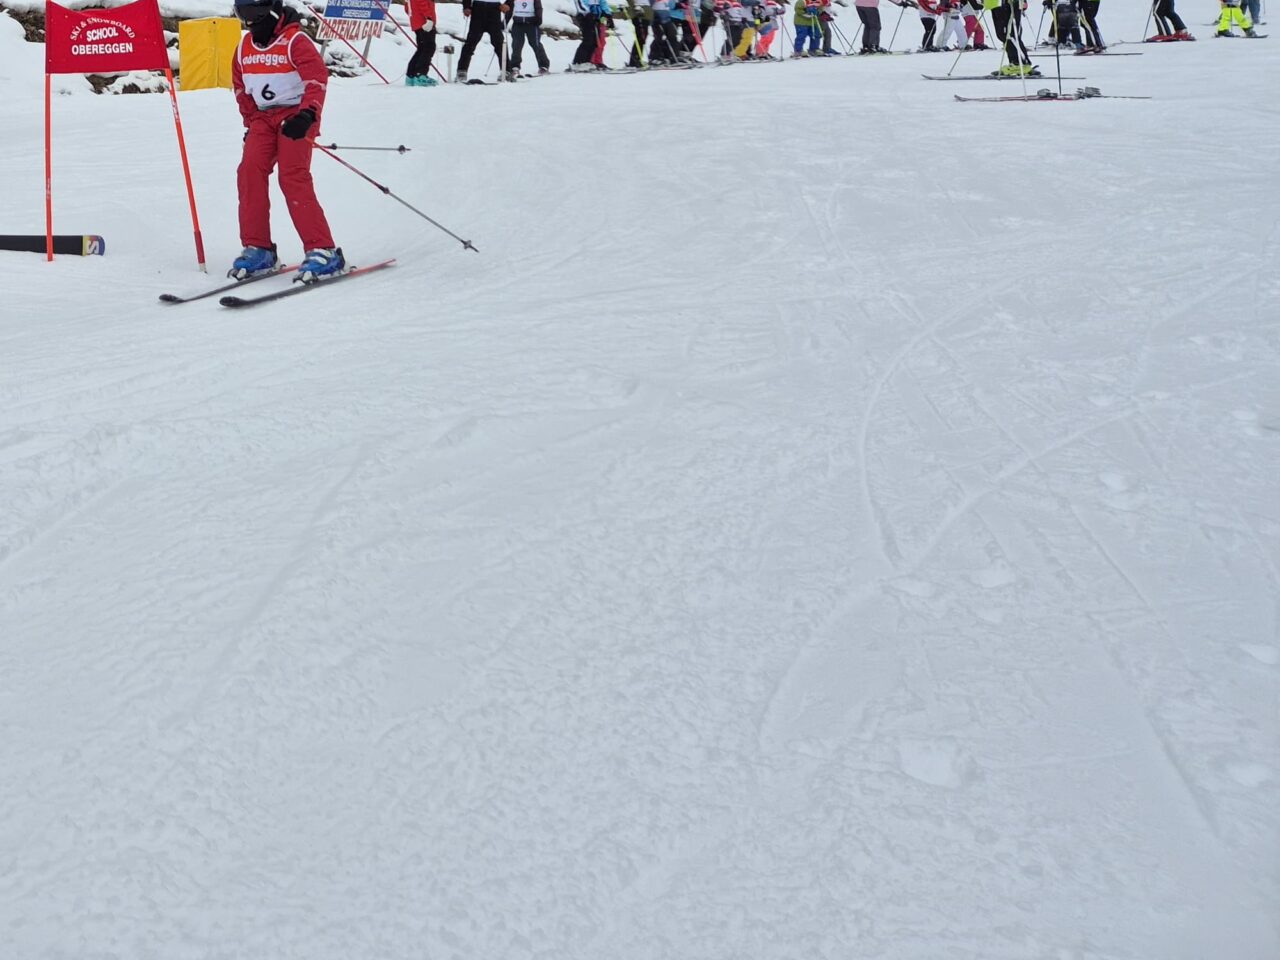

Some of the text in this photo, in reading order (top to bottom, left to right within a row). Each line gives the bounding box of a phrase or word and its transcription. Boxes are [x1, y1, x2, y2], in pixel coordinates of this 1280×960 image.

[70, 17, 135, 40] SKI & SNOWBOARD
[86, 27, 119, 42] SCHOOL
[319, 19, 383, 40] PARTENZA GARA
[71, 43, 133, 55] OBEREGGEN
[261, 83, 275, 100] 6
